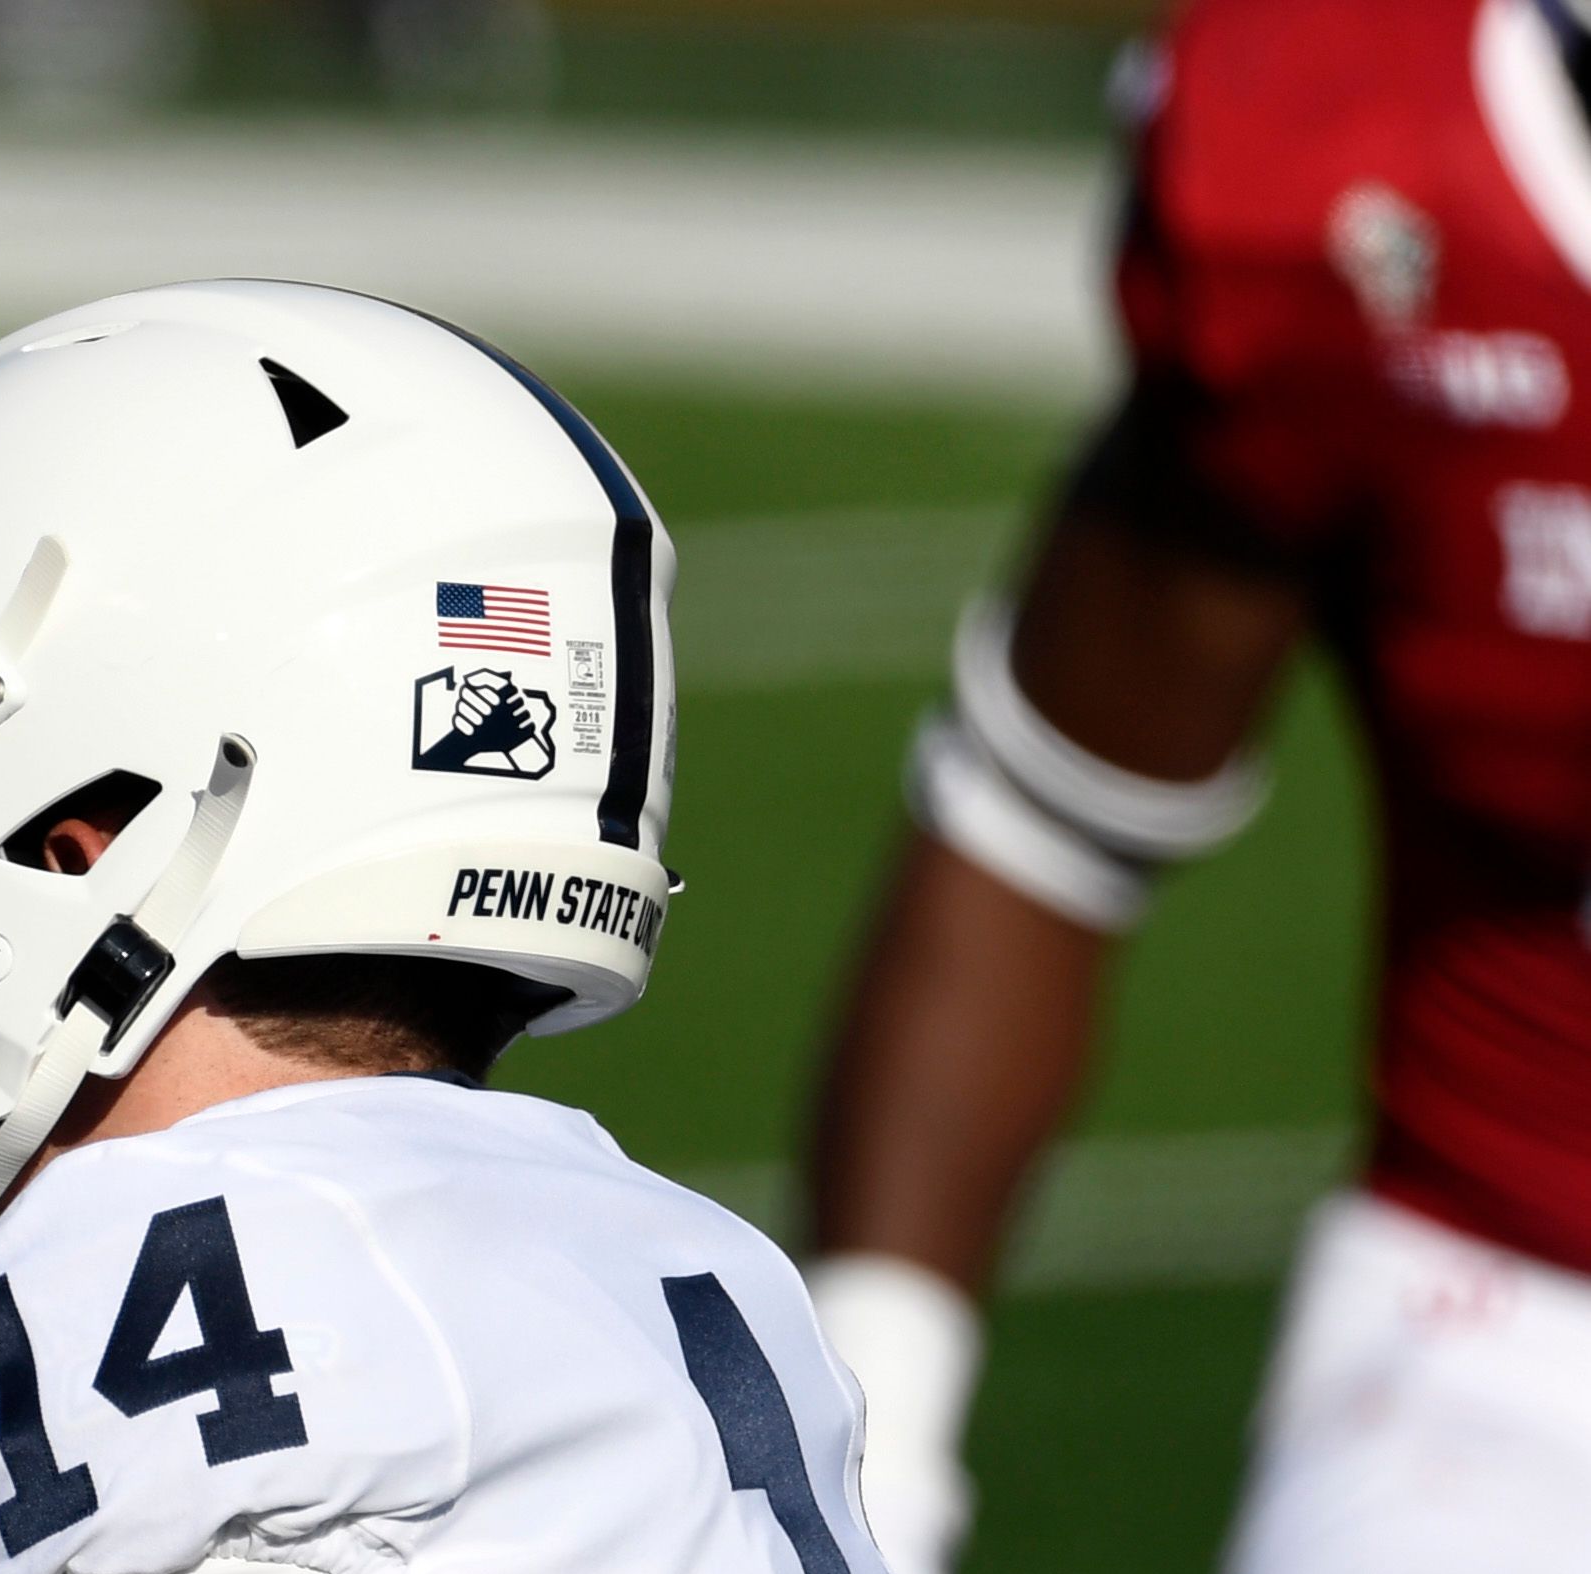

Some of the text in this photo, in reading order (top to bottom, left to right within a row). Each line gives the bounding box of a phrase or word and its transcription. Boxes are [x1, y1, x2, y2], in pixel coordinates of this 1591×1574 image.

[575, 711, 600, 723] 2018
[446, 868, 555, 921] PENN
[556, 876, 641, 941] STATE
